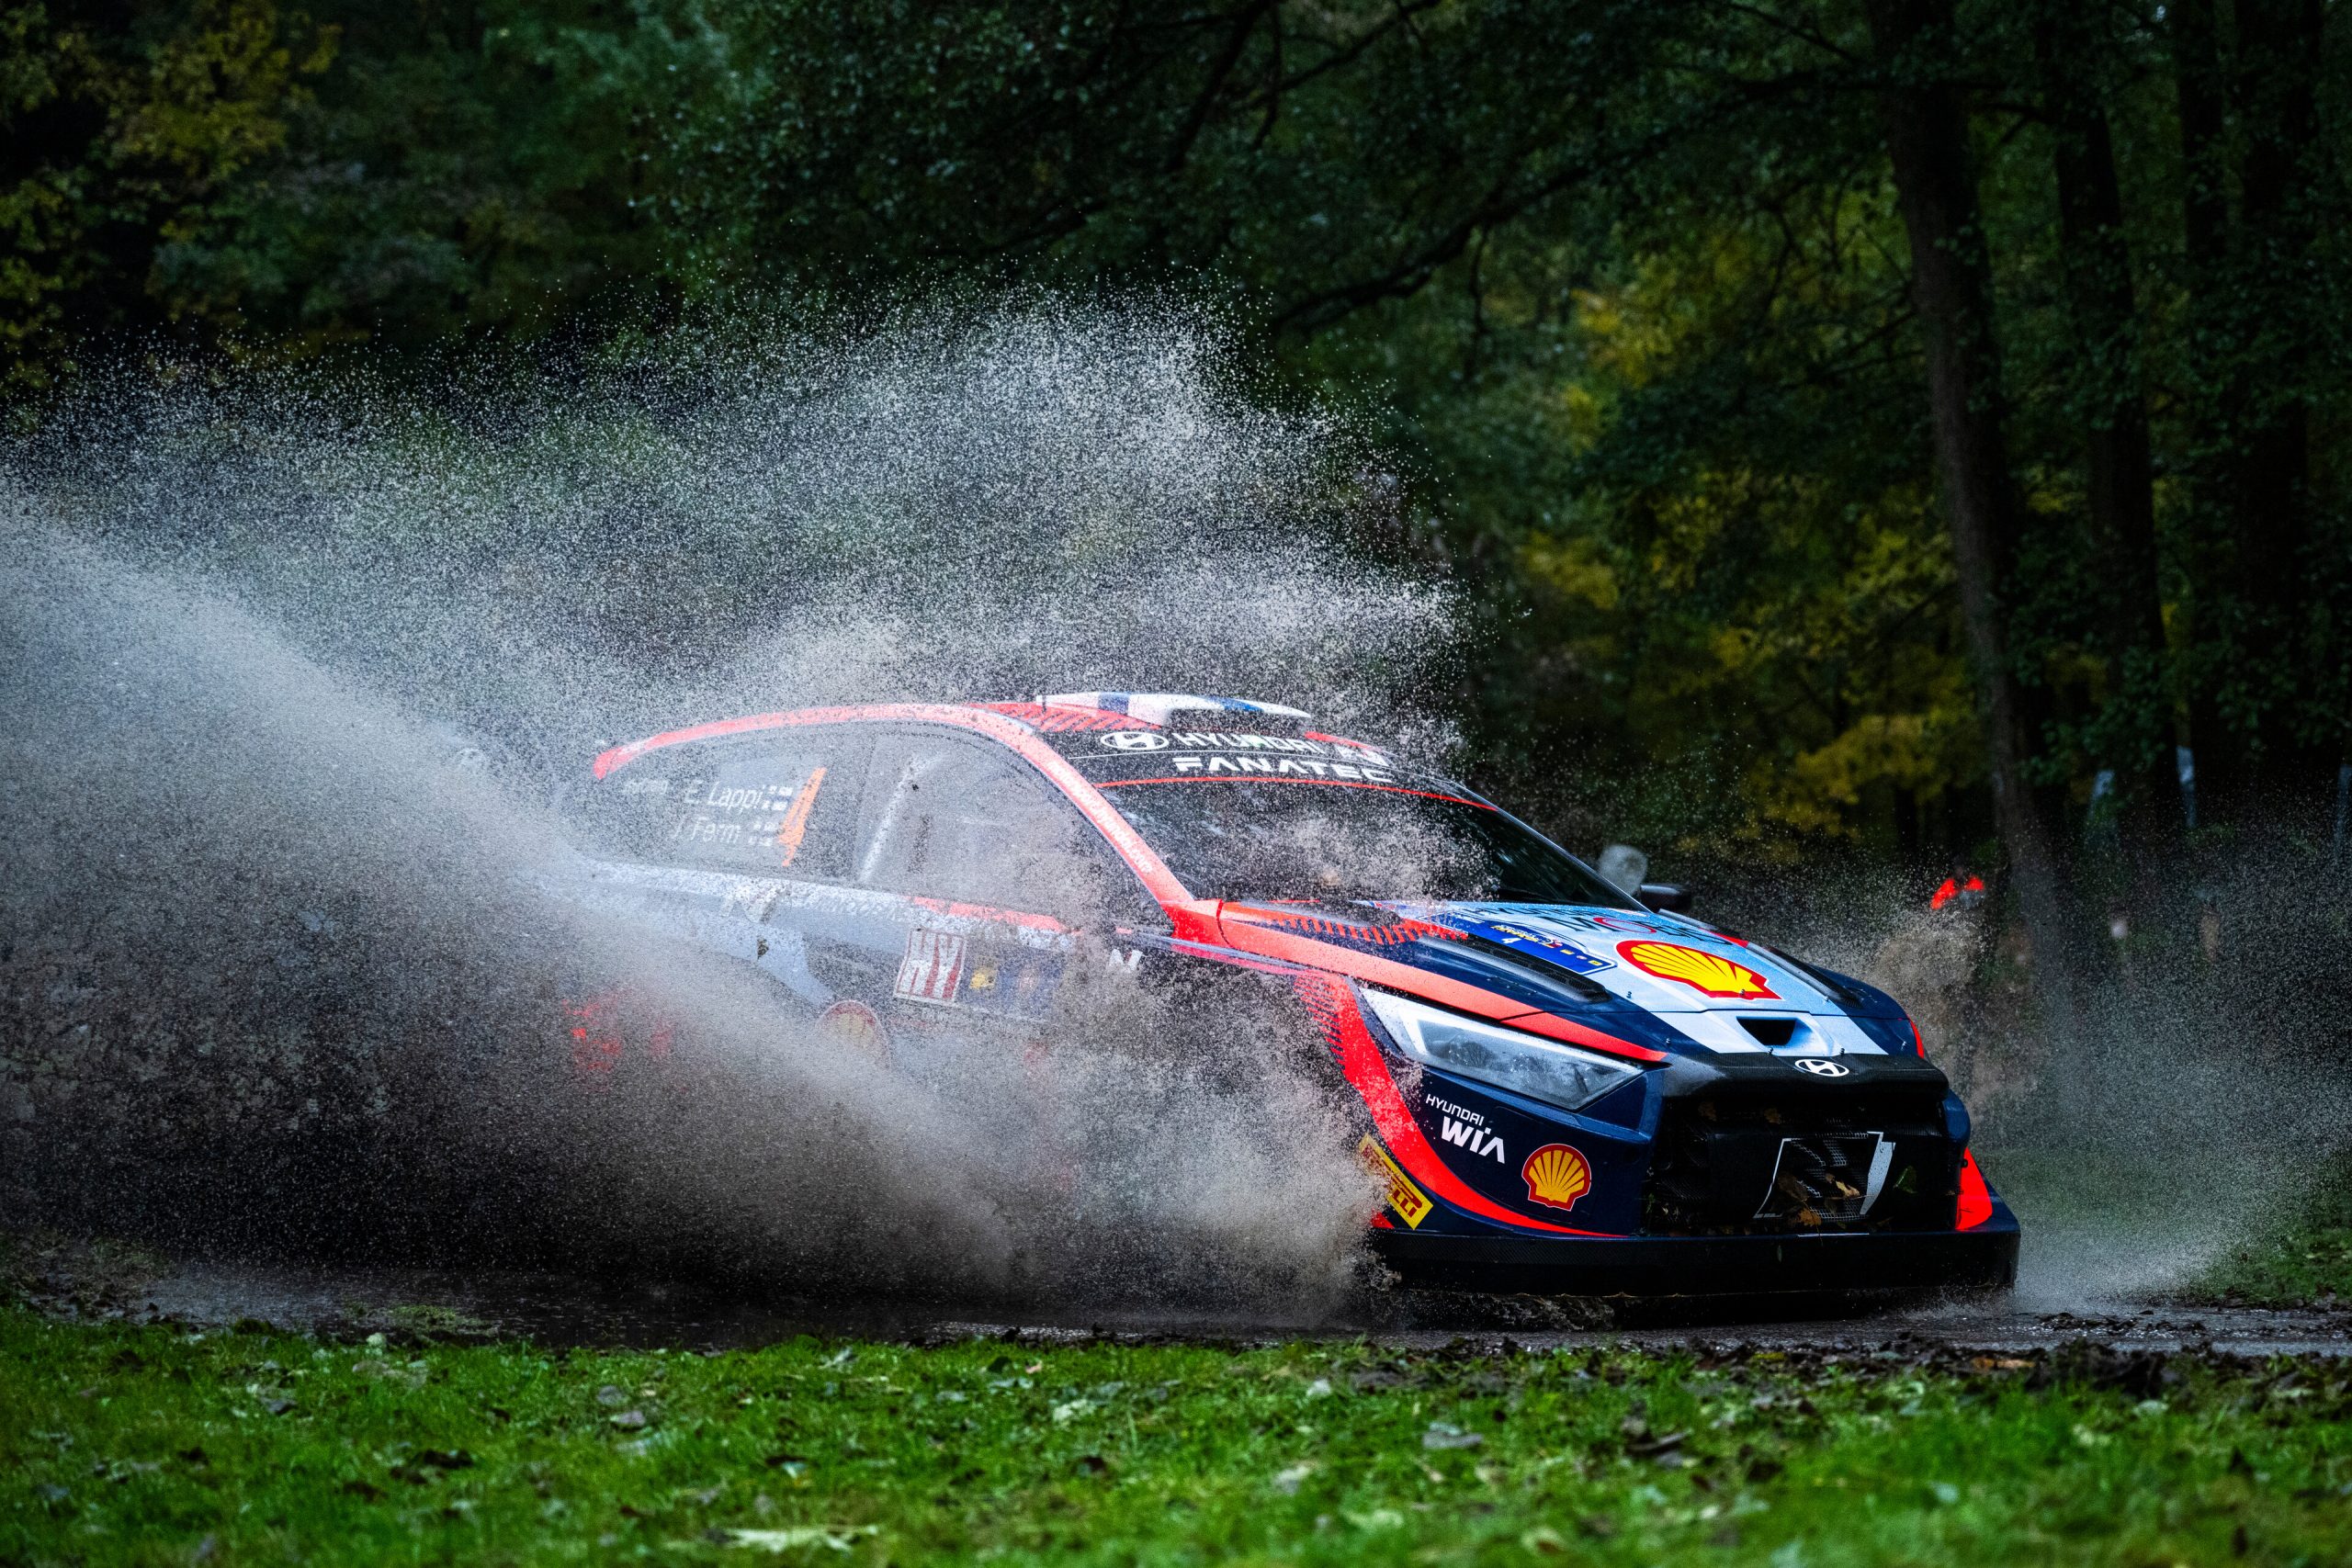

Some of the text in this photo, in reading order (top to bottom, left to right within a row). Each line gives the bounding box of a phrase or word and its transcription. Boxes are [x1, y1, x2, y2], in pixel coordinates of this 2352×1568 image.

[1172, 731, 1325, 754] HYUNDAI
[1172, 757, 1395, 784] FANATEC
[1425, 1093, 1485, 1126] HYUNDAI
[1441, 1115, 1506, 1165] WIA
